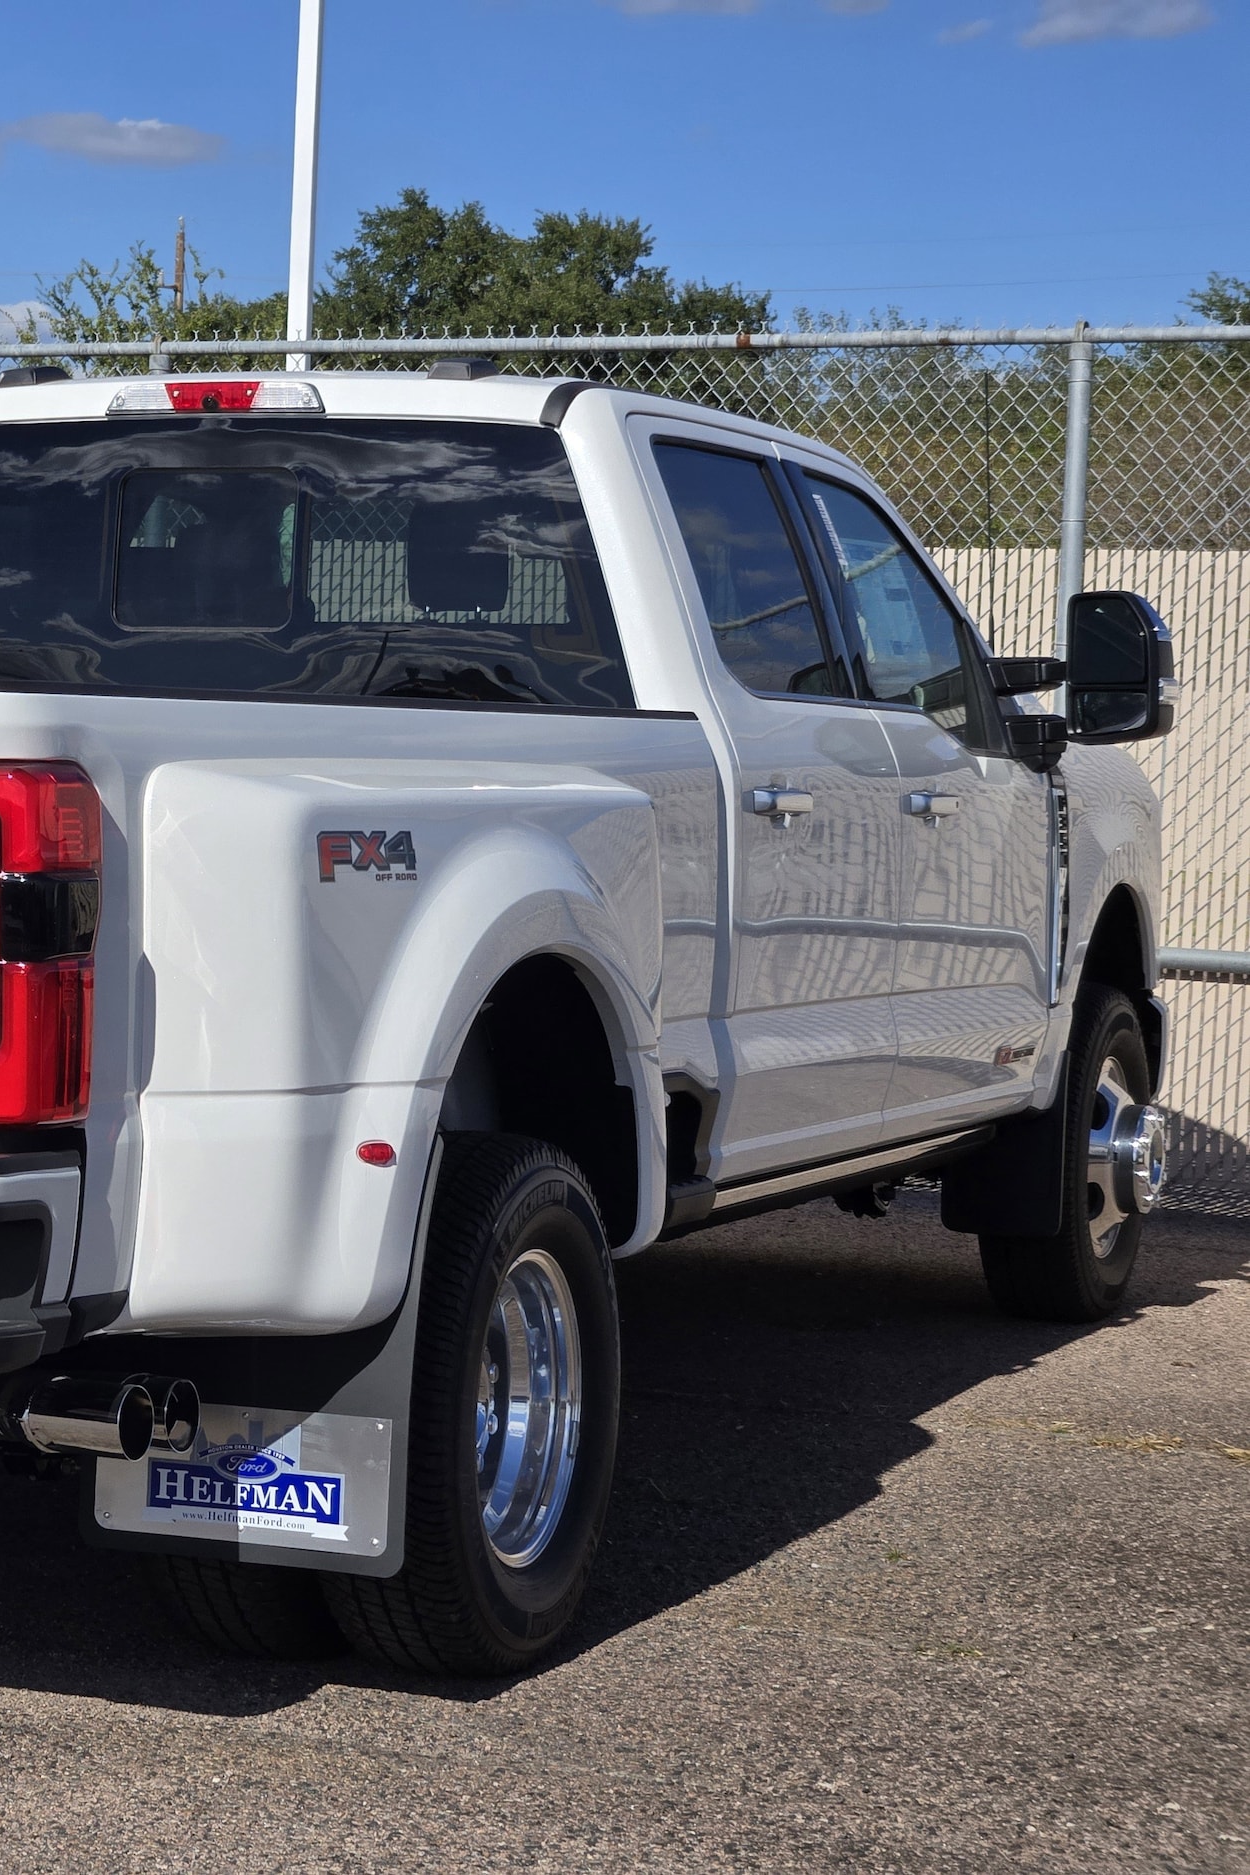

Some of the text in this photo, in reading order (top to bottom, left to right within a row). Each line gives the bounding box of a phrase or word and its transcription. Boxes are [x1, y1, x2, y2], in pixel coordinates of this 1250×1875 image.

[316, 830, 417, 883] FX4
[375, 872, 418, 882] OFF ROAD
[226, 1455, 268, 1473] Ford
[155, 1467, 337, 1516] HELFMAN
[181, 1510, 306, 1531] www.HelfmanFord.com
